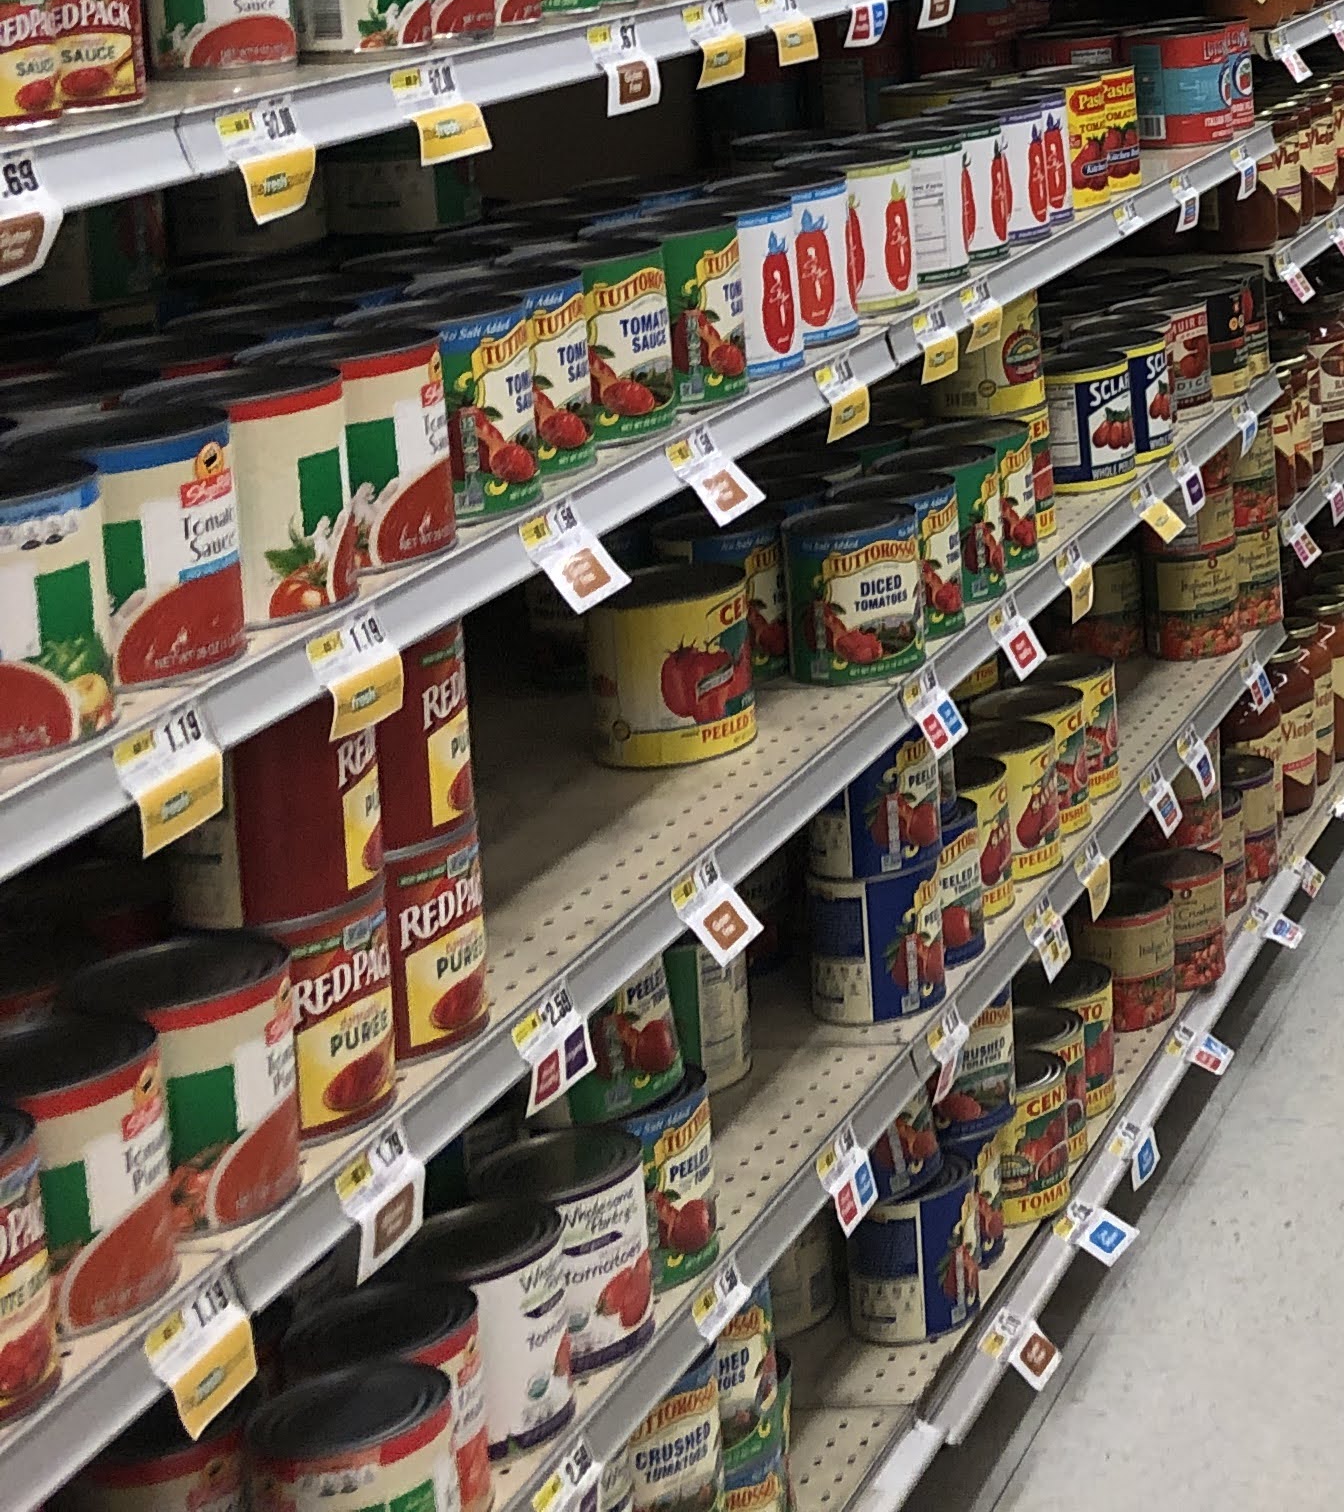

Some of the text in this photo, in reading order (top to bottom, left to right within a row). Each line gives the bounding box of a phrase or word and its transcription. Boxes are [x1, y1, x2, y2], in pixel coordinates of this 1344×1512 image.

[49, 0, 132, 31] EDPACK
[60, 43, 116, 66] SAUCE
[1080, 119, 1105, 134] TOMA
[2, 159, 37, 197] .69
[557, 342, 587, 364] TOMA
[1090, 375, 1129, 406] SCLA
[183, 509, 235, 540] Tomat
[854, 590, 908, 613] TOMATOES
[860, 575, 903, 598] DICED
[350, 617, 382, 652] 1.19
[164, 710, 203, 751] 1.19
[400, 881, 483, 949] REDPA
[331, 1019, 388, 1057] PUREE
[961, 1036, 1006, 1063] RUSHED
[1026, 1081, 1067, 1116] CEN
[669, 1147, 711, 1183] PEELE
[635, 1421, 711, 1471] CRUSHED
